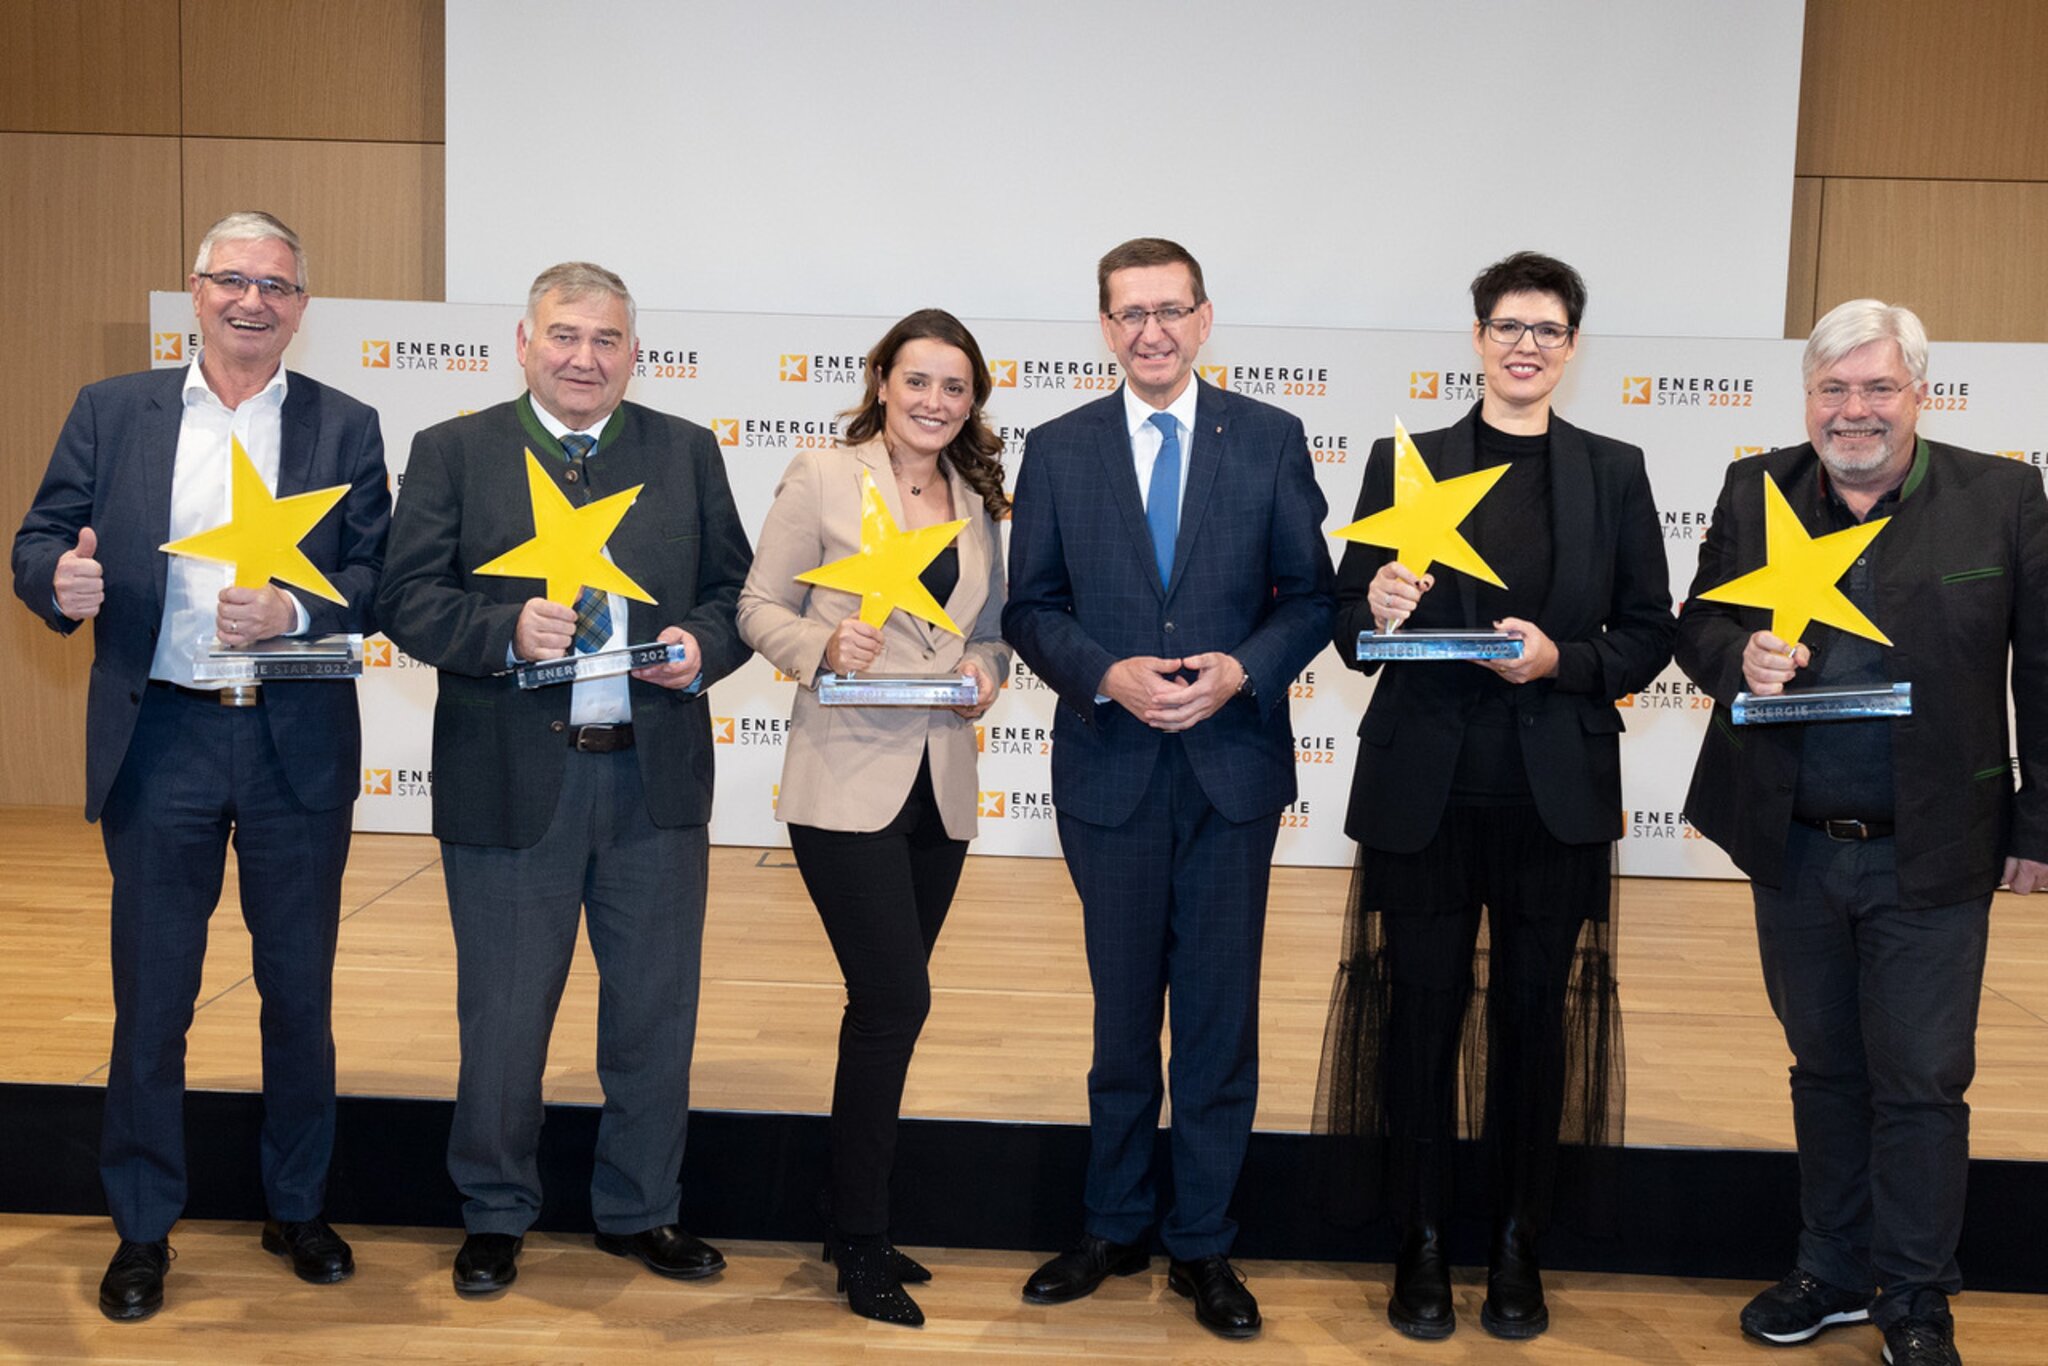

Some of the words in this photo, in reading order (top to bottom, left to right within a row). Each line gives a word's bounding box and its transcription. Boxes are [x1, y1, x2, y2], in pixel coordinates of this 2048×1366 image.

[397, 342, 489, 357] ENERGIE
[637, 350, 698, 364] ERGIE
[815, 356, 867, 369] ENER
[396, 357, 438, 370] STAR
[446, 358, 489, 372] 2022
[655, 365, 697, 378] 2022
[1024, 361, 1117, 375] ENERGIE
[814, 370, 856, 383] STAR
[1234, 367, 1328, 381] ENERGIE
[1023, 375, 1065, 389] STAR
[1073, 377, 1117, 390] 2022
[1233, 381, 1276, 395] STAR
[1283, 383, 1327, 396] 2022
[1658, 377, 1753, 392] ENERGIE
[1657, 392, 1701, 406] STAR
[1708, 394, 1752, 407] 2022
[1923, 397, 1968, 411] 2022
[746, 420, 838, 434] ENERGIE
[745, 434, 788, 448] STAR
[1310, 450, 1347, 463] 022
[1660, 526, 1693, 540] TAR
[315, 663, 350, 674] 2022
[1015, 677, 1050, 690] STA
[1640, 695, 1683, 709] STAR
[1691, 696, 1712, 710] 20
[741, 718, 791, 731] ENER
[740, 732, 782, 746] STAR
[992, 727, 1047, 740] ENER
[991, 741, 1033, 755] STAR
[398, 783, 432, 797] STA
[1010, 806, 1053, 820] STAR
[1634, 811, 1688, 825] ENER
[1633, 825, 1676, 839] STAR
